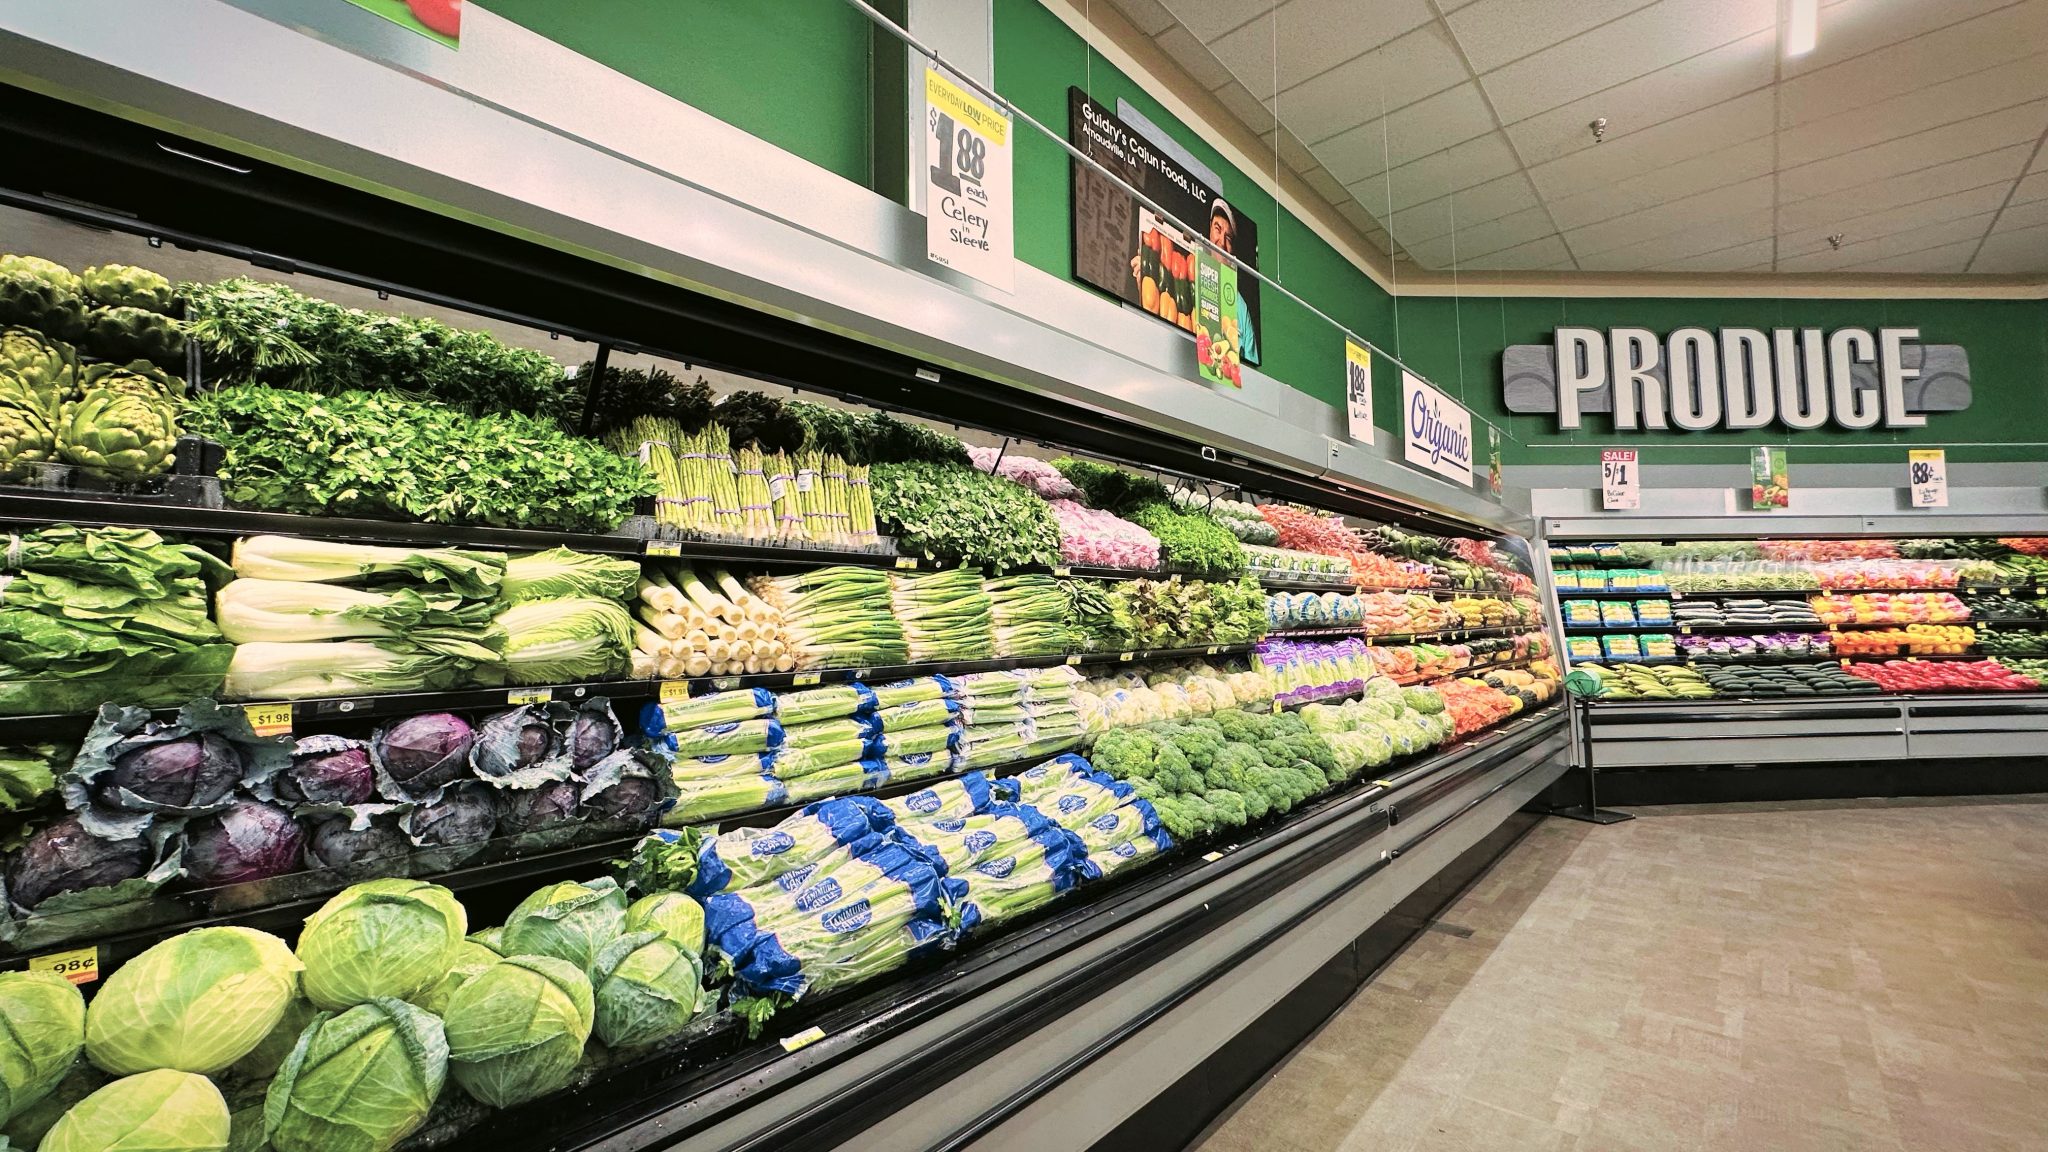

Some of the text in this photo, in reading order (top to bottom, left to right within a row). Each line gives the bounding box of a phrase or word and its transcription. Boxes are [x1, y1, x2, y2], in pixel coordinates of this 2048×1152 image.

[929, 79, 1005, 137] EVERYDAY LOW PRICE
[1082, 103, 1207, 204] Guidry's Cajun Foods, LLC
[1127, 153, 1137, 168] LA
[967, 186, 988, 201] each
[941, 196, 988, 239] Celery
[962, 223, 970, 233] in
[950, 228, 990, 251] Sleeve
[1200, 262, 1219, 284] SUPER
[1553, 326, 1928, 430] PRODUCE
[1410, 390, 1469, 465] Organic
[1603, 451, 1634, 461] SALE!
[258, 713, 290, 725] $1.98
[824, 901, 869, 930] TANIMURA
[53, 957, 95, 974] 98¢
